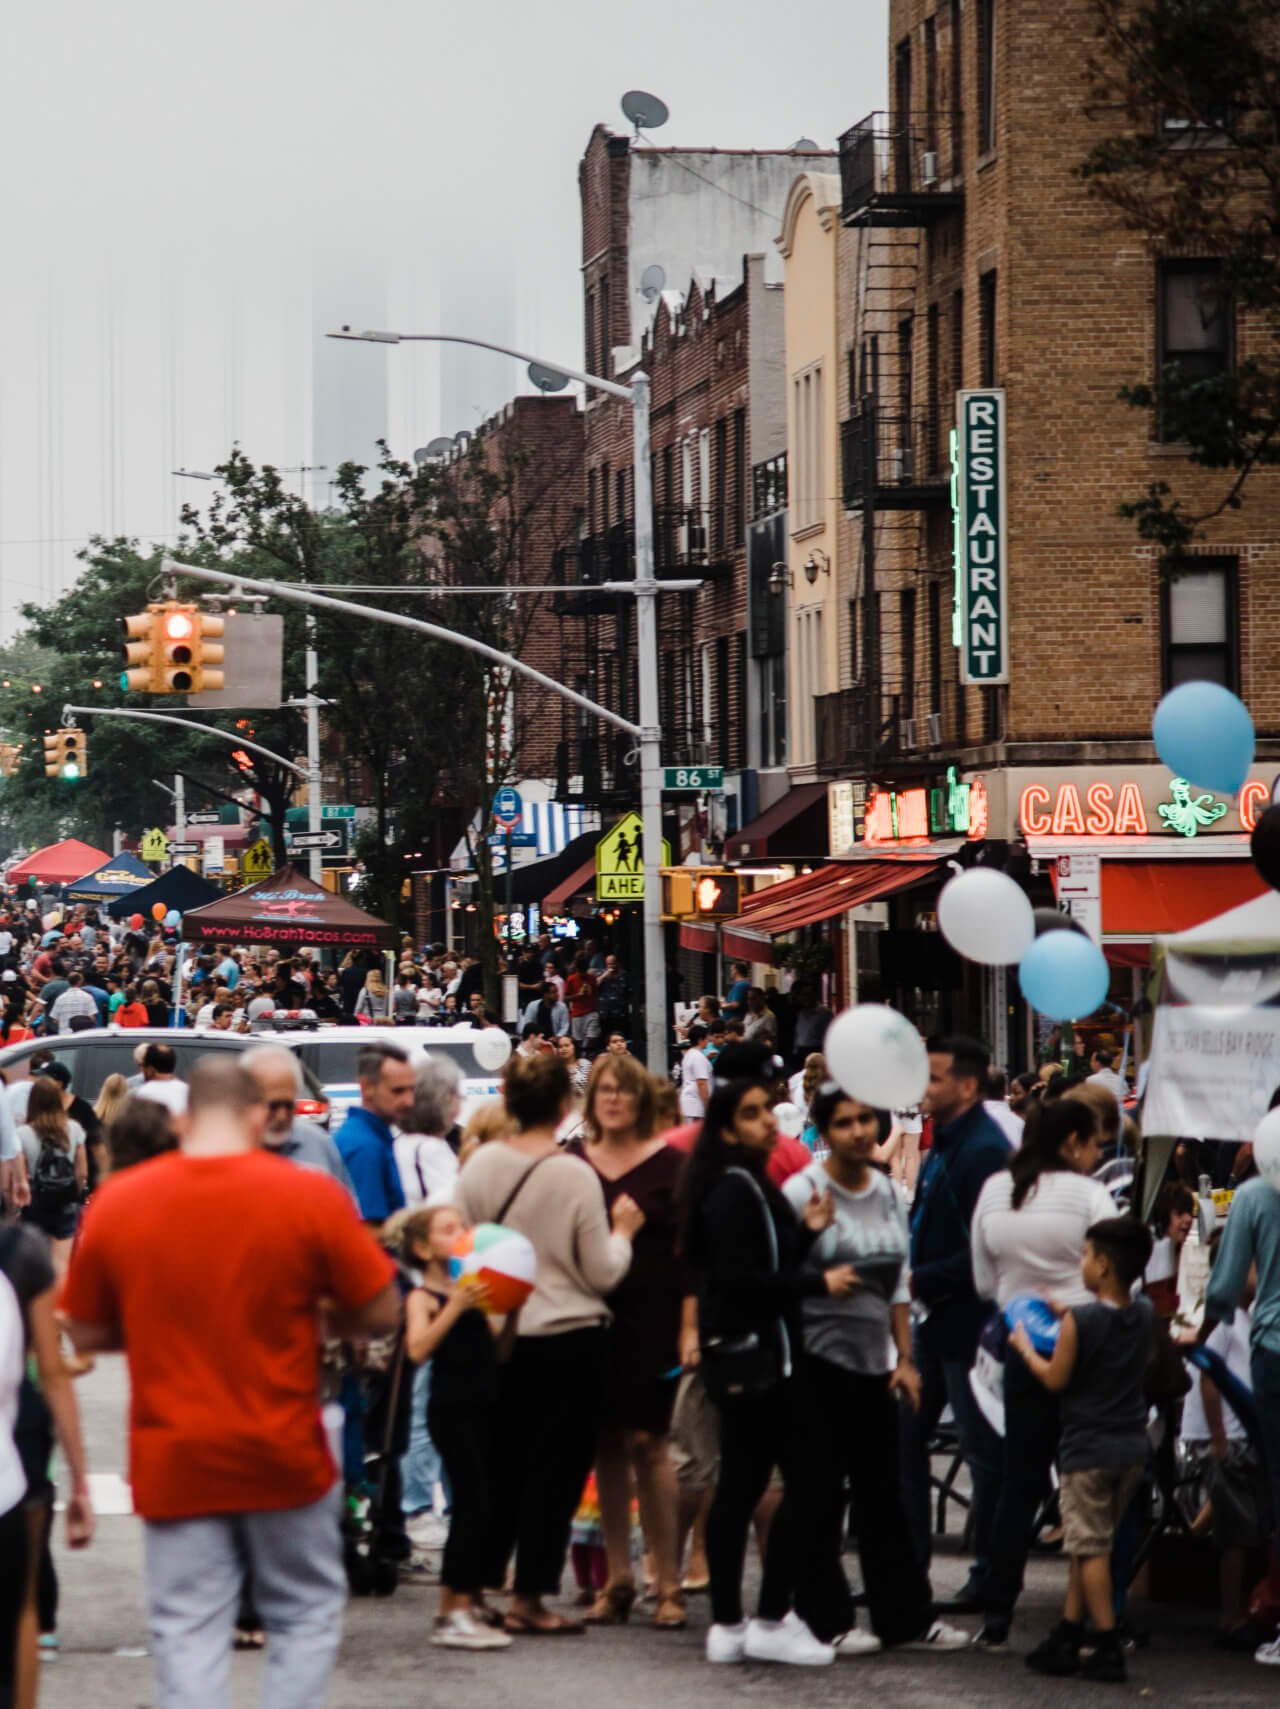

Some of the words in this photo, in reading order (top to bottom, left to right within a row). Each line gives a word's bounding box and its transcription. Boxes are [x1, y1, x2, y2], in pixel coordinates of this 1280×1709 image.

[968, 402, 998, 674] RESTAURANT
[676, 770, 702, 787] 86
[707, 769, 720, 778] ST
[1020, 782, 1148, 835] CASA
[607, 878, 645, 894] AHE
